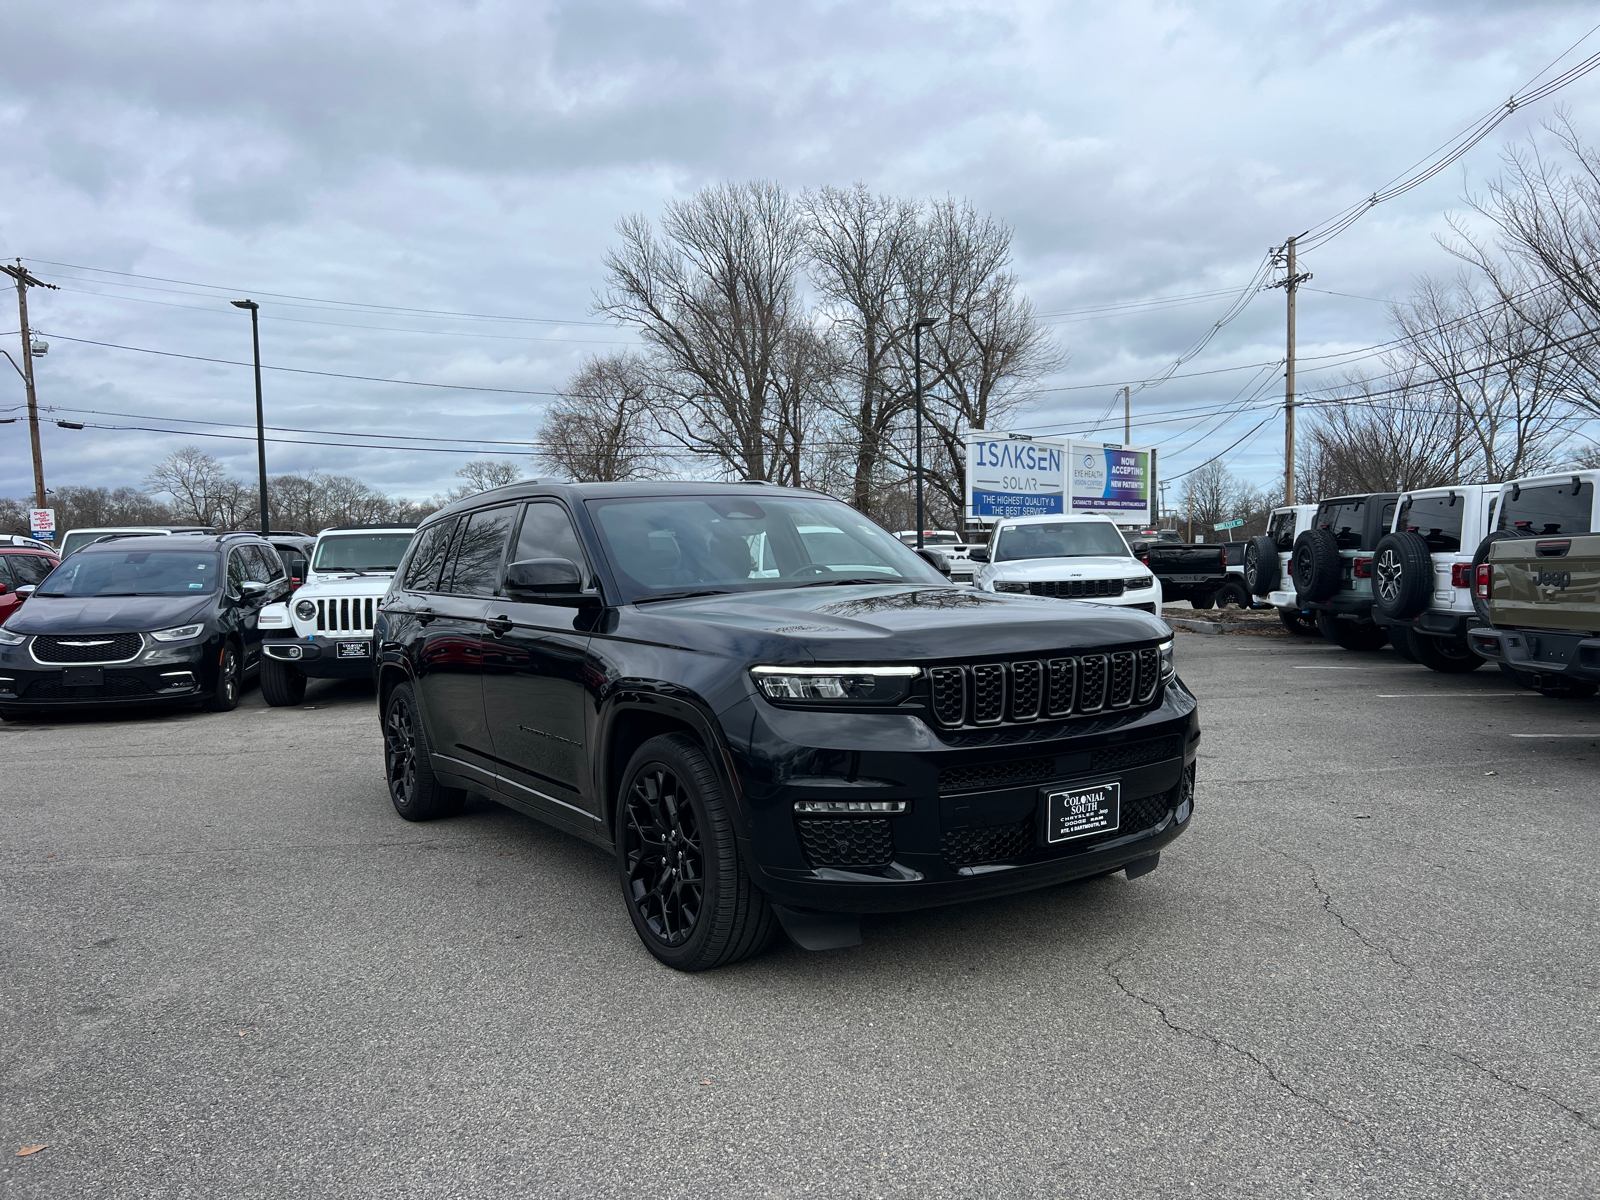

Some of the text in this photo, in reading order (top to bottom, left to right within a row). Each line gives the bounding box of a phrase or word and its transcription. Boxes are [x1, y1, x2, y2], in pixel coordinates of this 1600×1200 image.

[976, 442, 1060, 472] ISAKSEN
[1121, 456, 1136, 466] NOW
[1074, 470, 1103, 478] EYE HEALTH
[1112, 466, 1144, 476] ACCEPTING
[1002, 476, 1038, 490] SOLAR
[982, 495, 1055, 506] THE HIGHEST QUALITY &
[992, 506, 1046, 515] THE BEST SERVICE
[1532, 566, 1571, 590] Jeep
[1064, 792, 1105, 807] COLONIAL
[1071, 801, 1098, 814] SOUTH
[1060, 812, 1094, 822] CHRYSLER
[1065, 818, 1086, 827] DODGE
